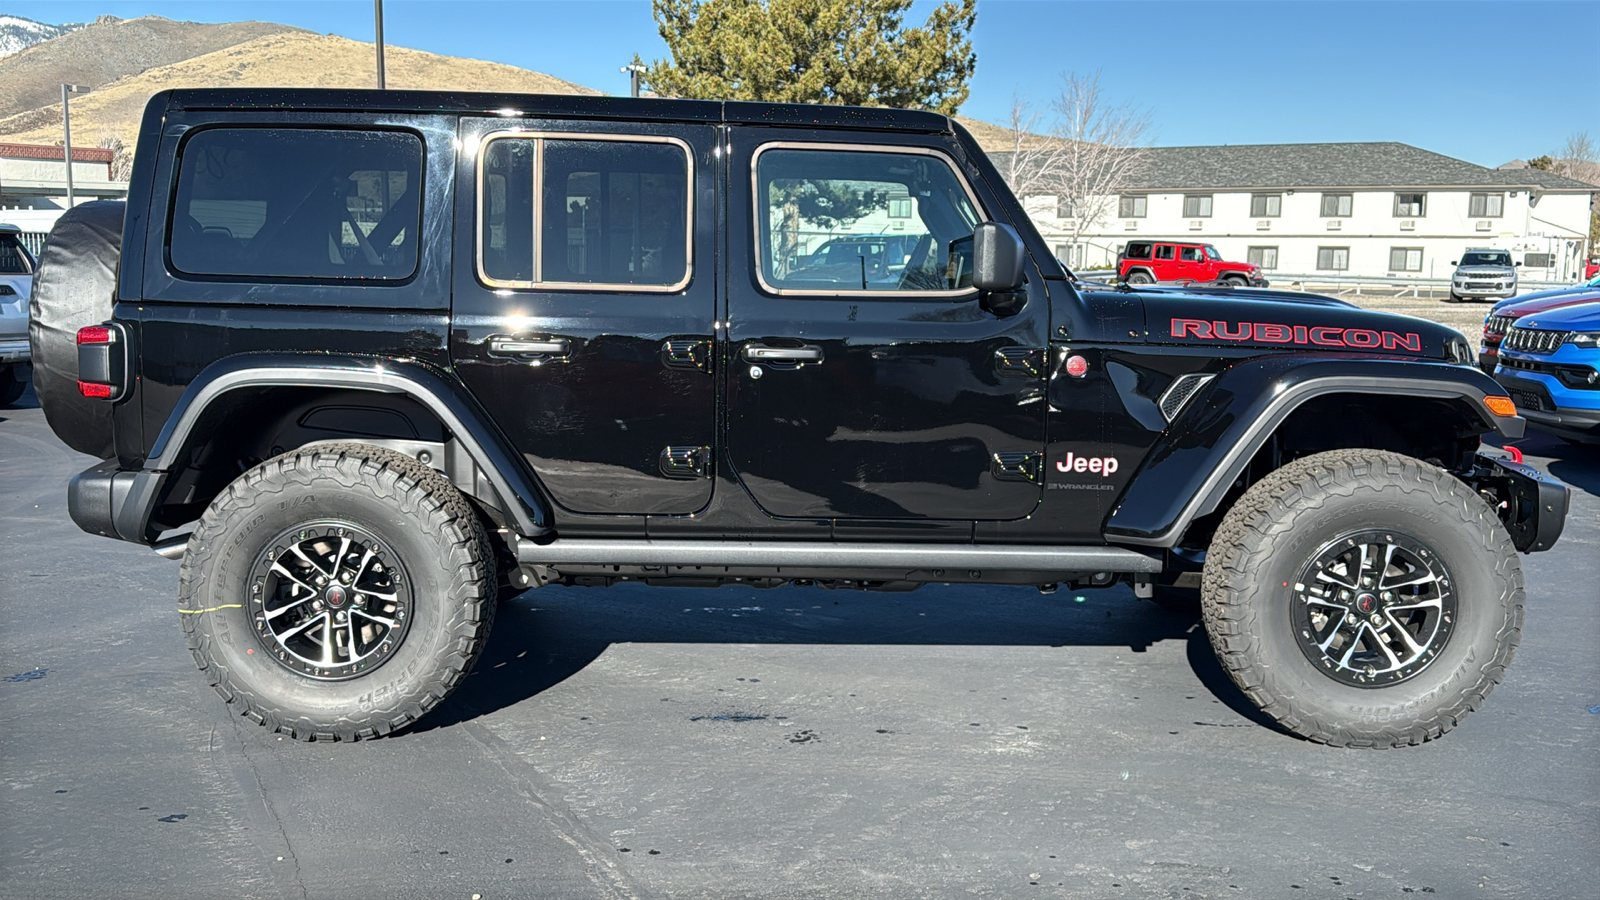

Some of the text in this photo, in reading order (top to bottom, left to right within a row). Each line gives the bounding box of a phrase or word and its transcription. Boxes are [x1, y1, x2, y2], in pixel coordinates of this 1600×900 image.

[1171, 318, 1421, 351] RUBICON
[1056, 451, 1119, 477] Jeep
[1058, 483, 1115, 491] WRANGLER
